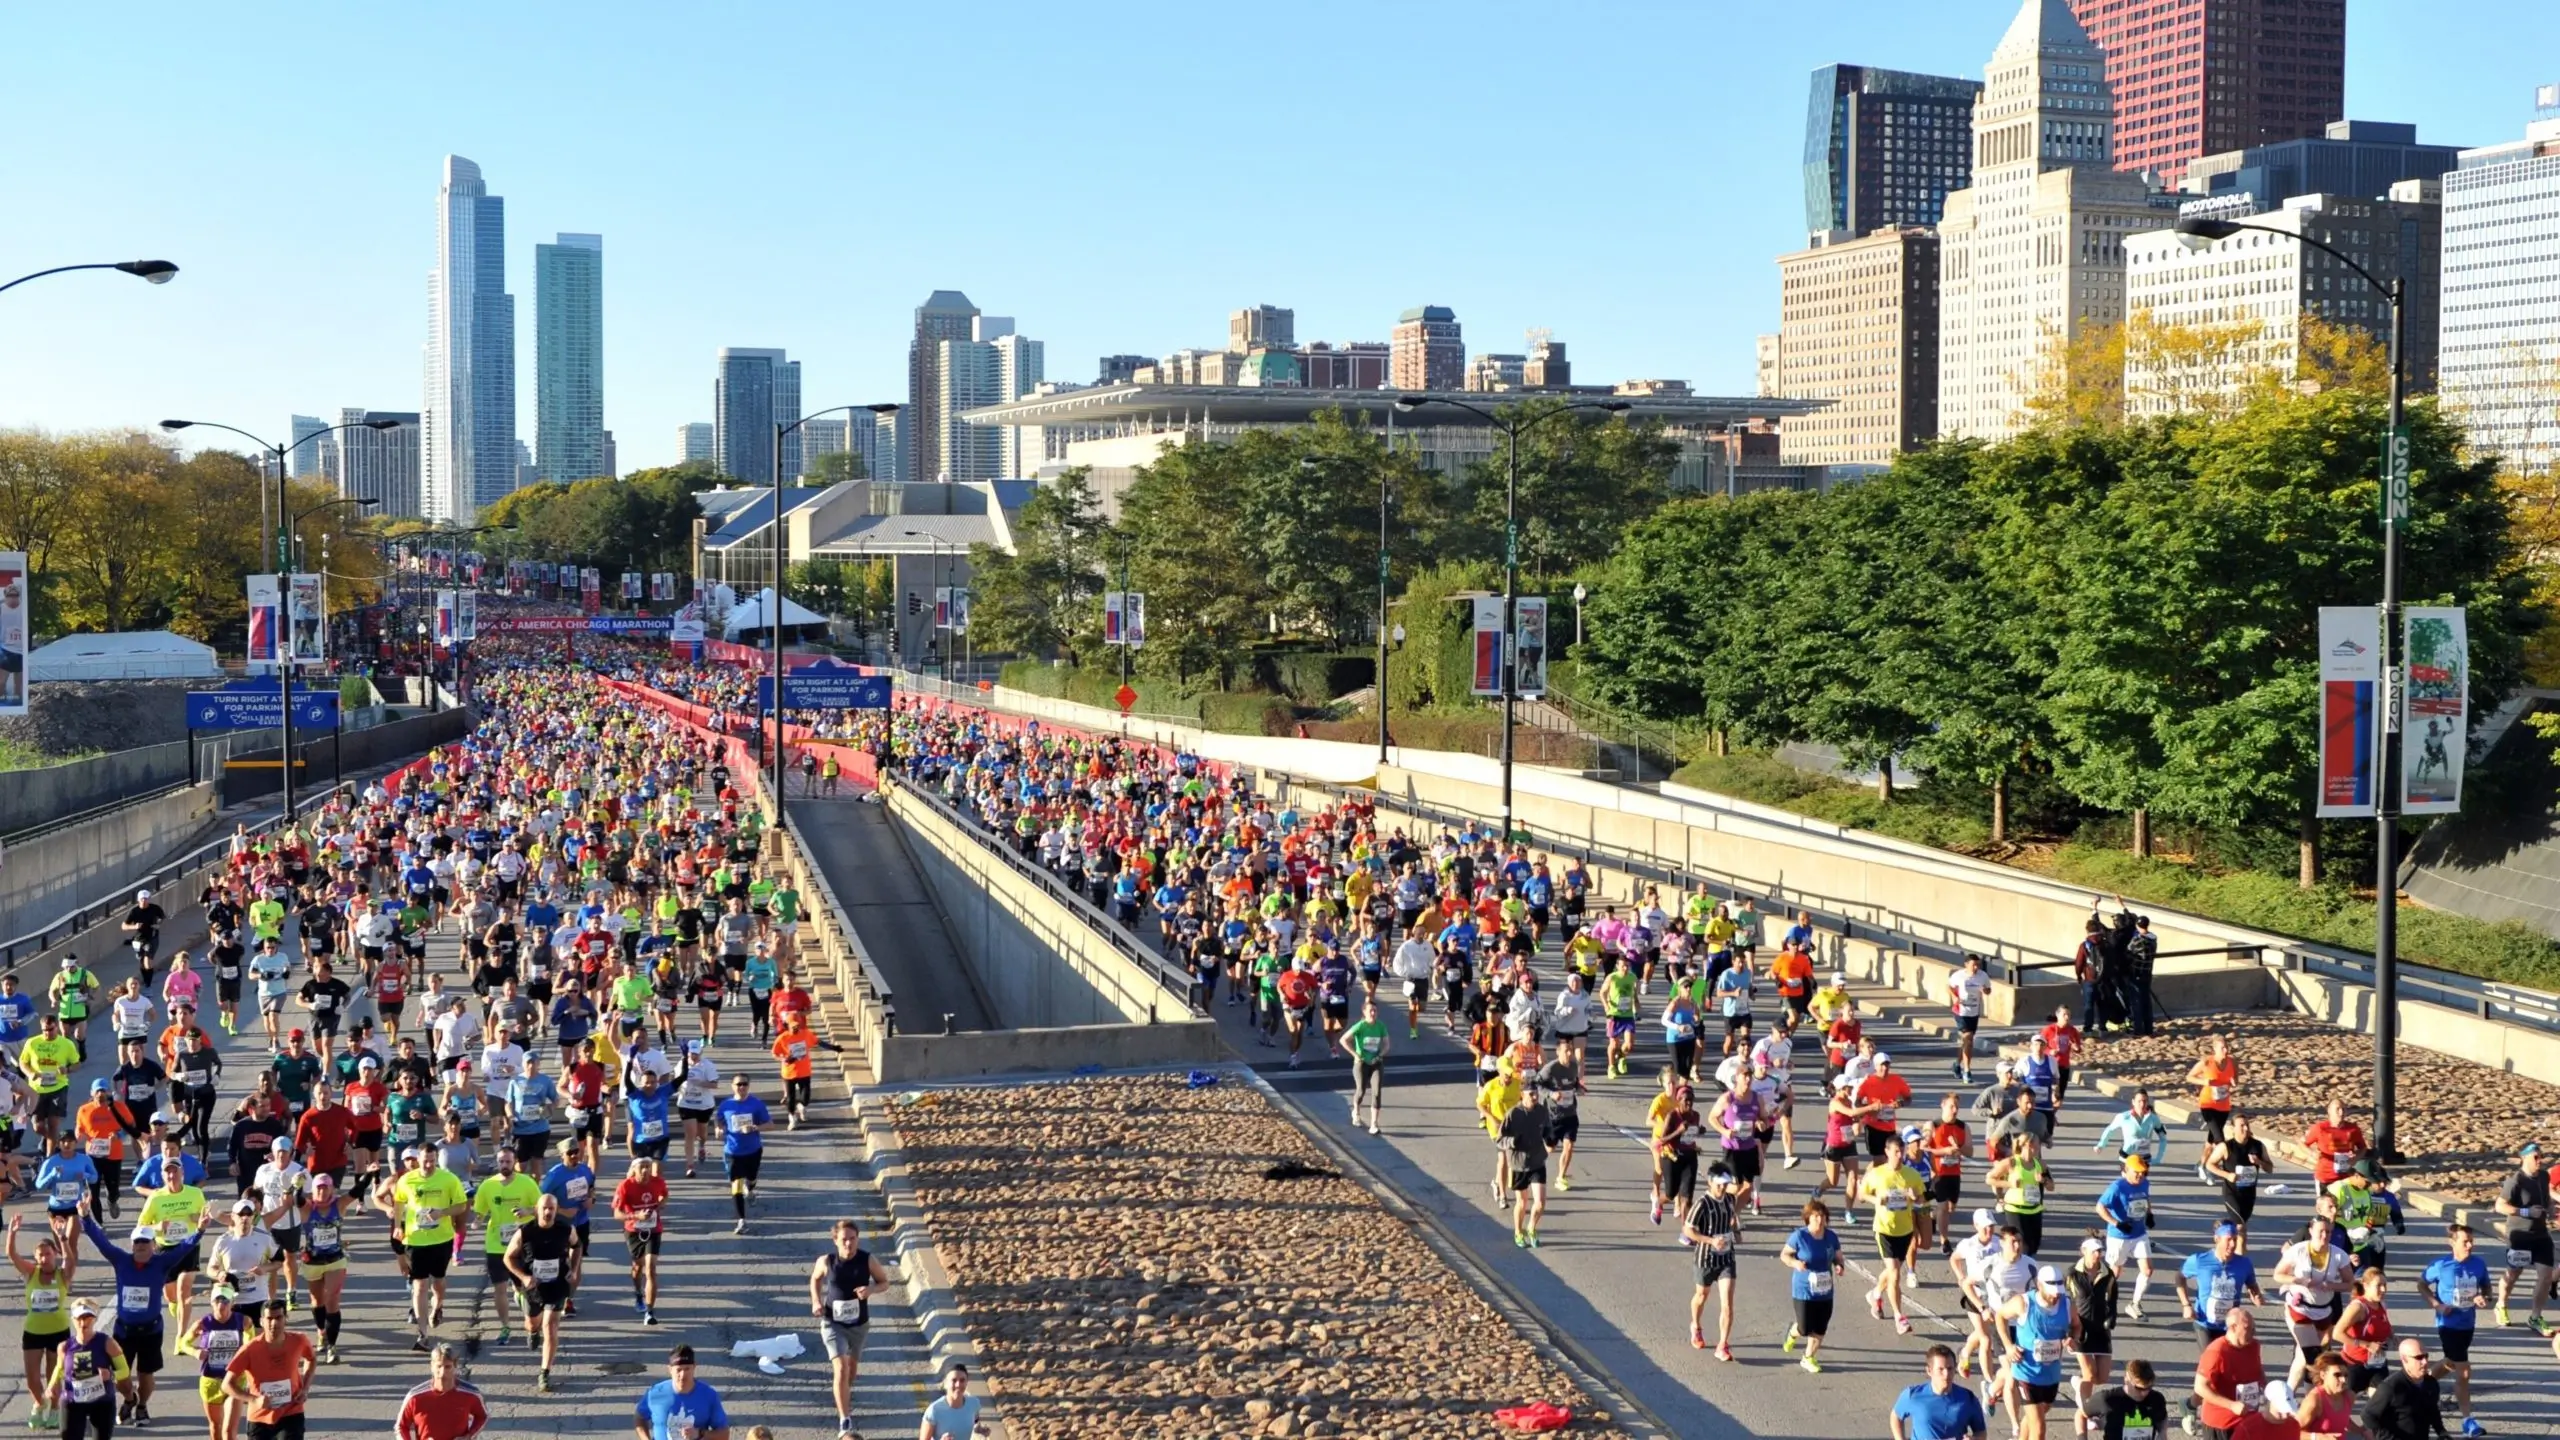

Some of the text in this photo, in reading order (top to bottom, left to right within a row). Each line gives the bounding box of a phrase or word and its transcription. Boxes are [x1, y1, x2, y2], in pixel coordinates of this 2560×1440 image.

[2179, 192, 2251, 214] MOTOROLA
[2393, 436, 2409, 518] C20N
[1508, 524, 1517, 563] C10N
[475, 620, 669, 630] ANK OF AMERICA CHICAGO MARATHON
[213, 695, 239, 703] TURN
[240, 695, 268, 703] RIGHT
[2389, 669, 2399, 729] C20N
